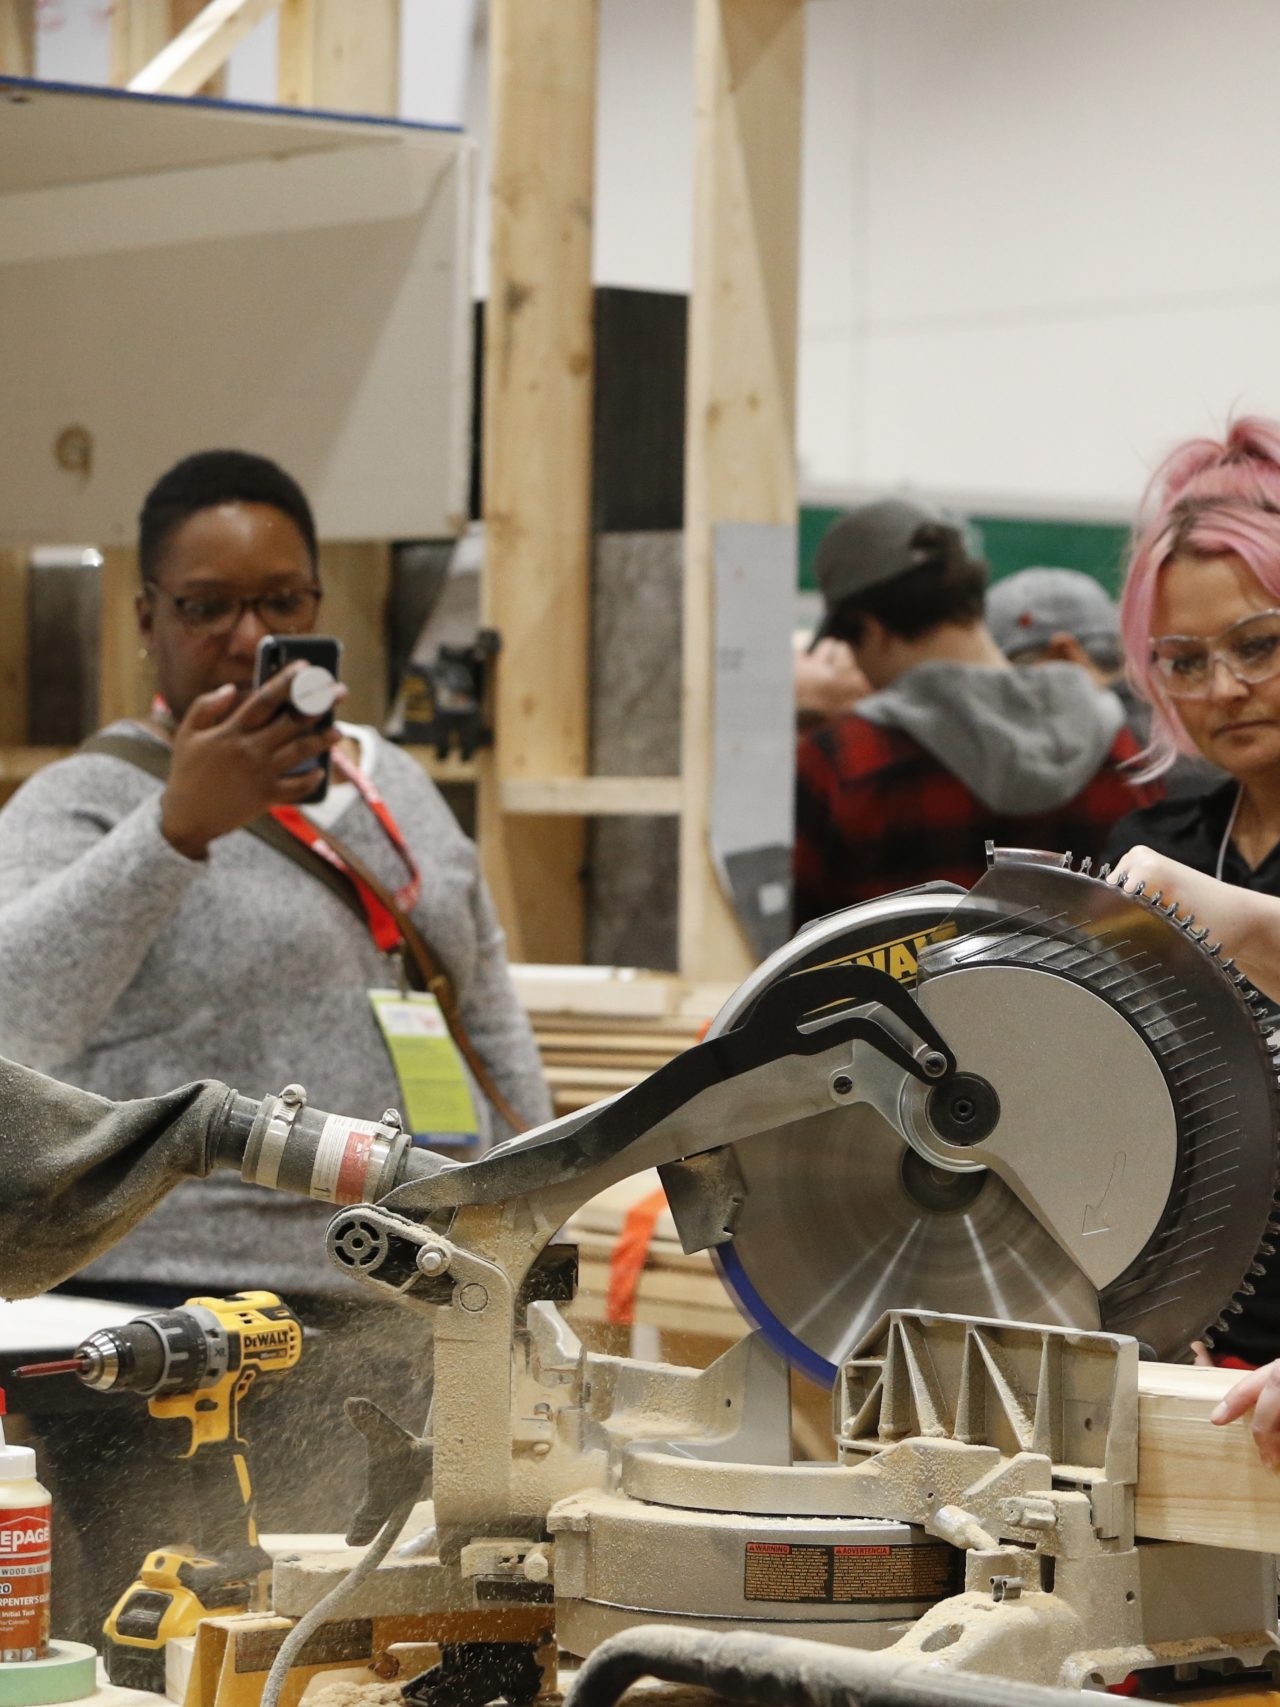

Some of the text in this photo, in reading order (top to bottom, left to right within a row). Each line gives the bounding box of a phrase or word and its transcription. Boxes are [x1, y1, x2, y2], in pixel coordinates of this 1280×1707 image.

[756, 1544, 788, 1553] WARNING
[843, 1546, 887, 1555] ADVERTENCIA
[1, 1567, 26, 1576] WOOD
